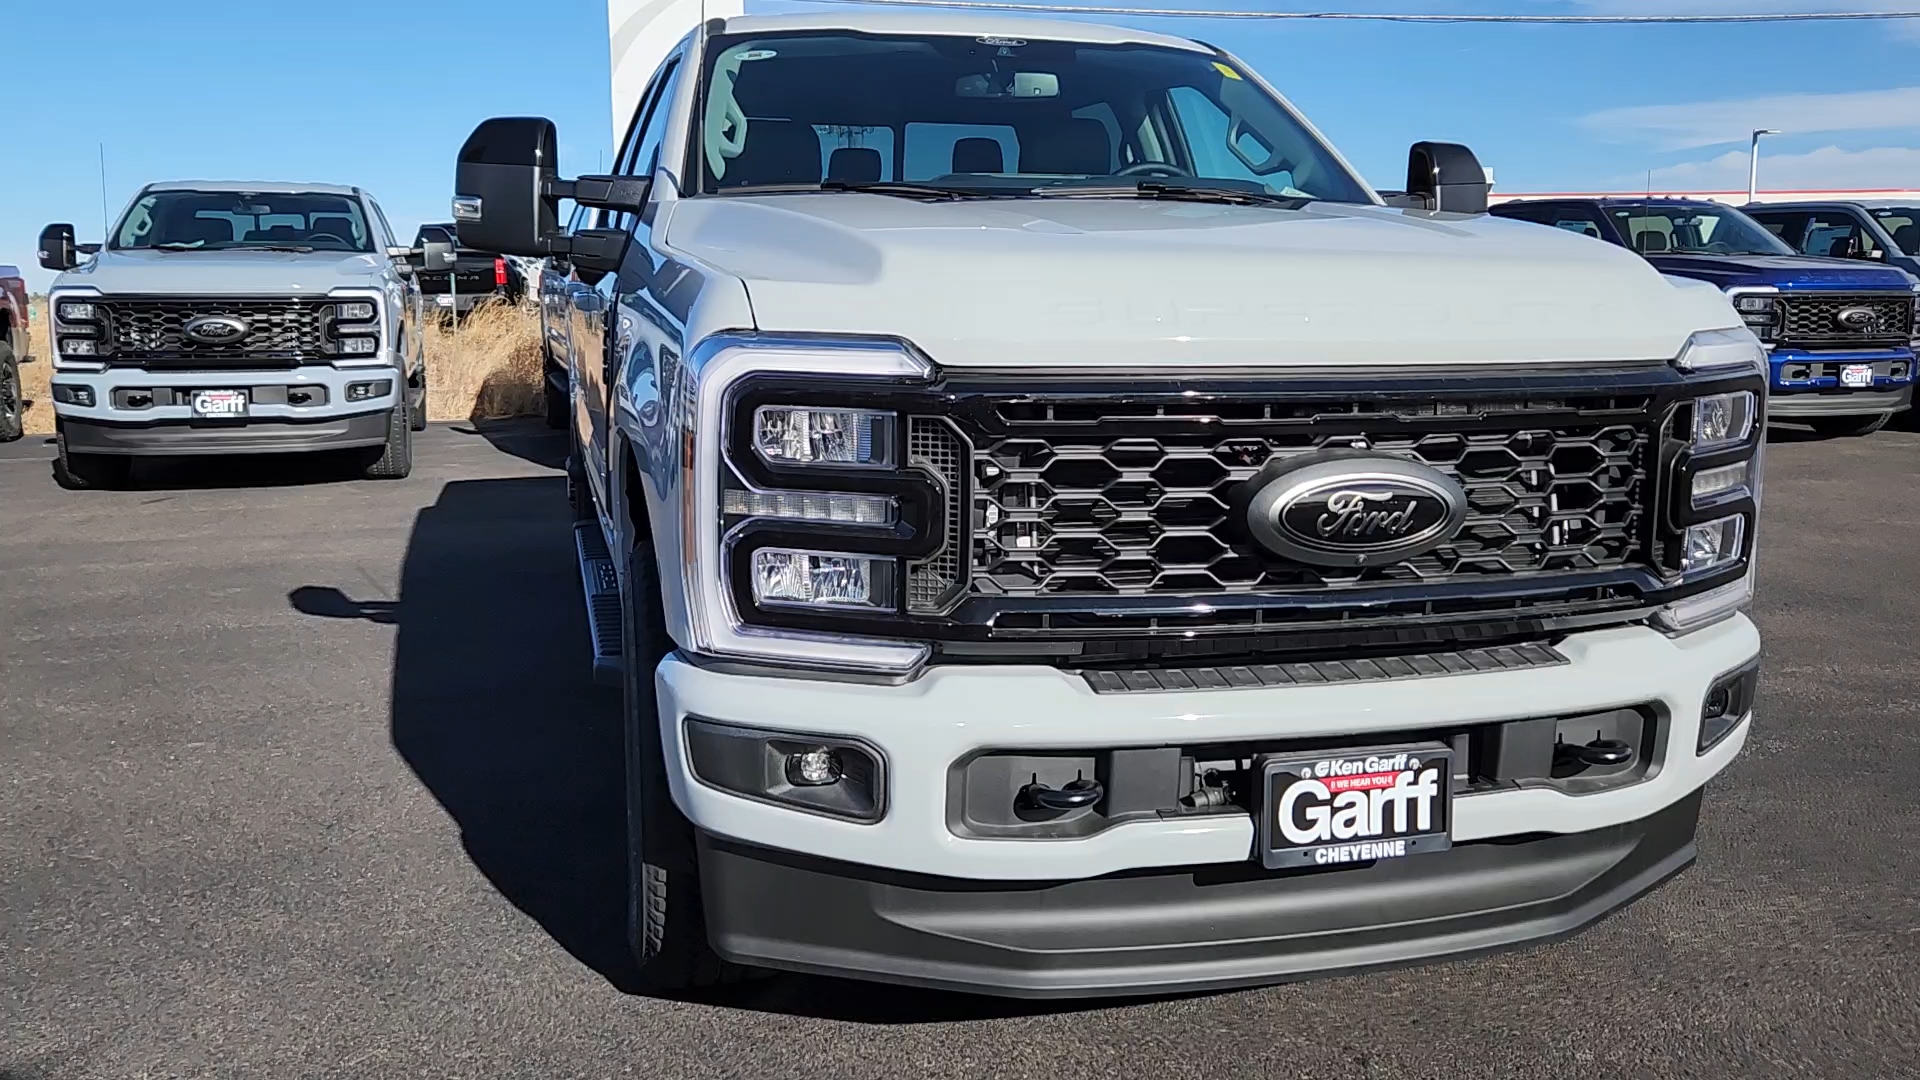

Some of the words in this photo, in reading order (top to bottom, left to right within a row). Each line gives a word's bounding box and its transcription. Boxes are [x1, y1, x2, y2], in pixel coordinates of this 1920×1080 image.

[200, 323, 231, 336] Ford
[1842, 368, 1873, 383] Garff
[195, 395, 245, 413] Garff
[1316, 490, 1418, 537] Ford
[1329, 759, 1364, 777] Ken
[1364, 754, 1408, 774] Garff
[1337, 780, 1350, 789] WE
[1350, 777, 1371, 788] HEAR
[1371, 775, 1388, 785] YOU
[1278, 768, 1438, 844] Garff
[1315, 840, 1406, 864] CHEYENNE
